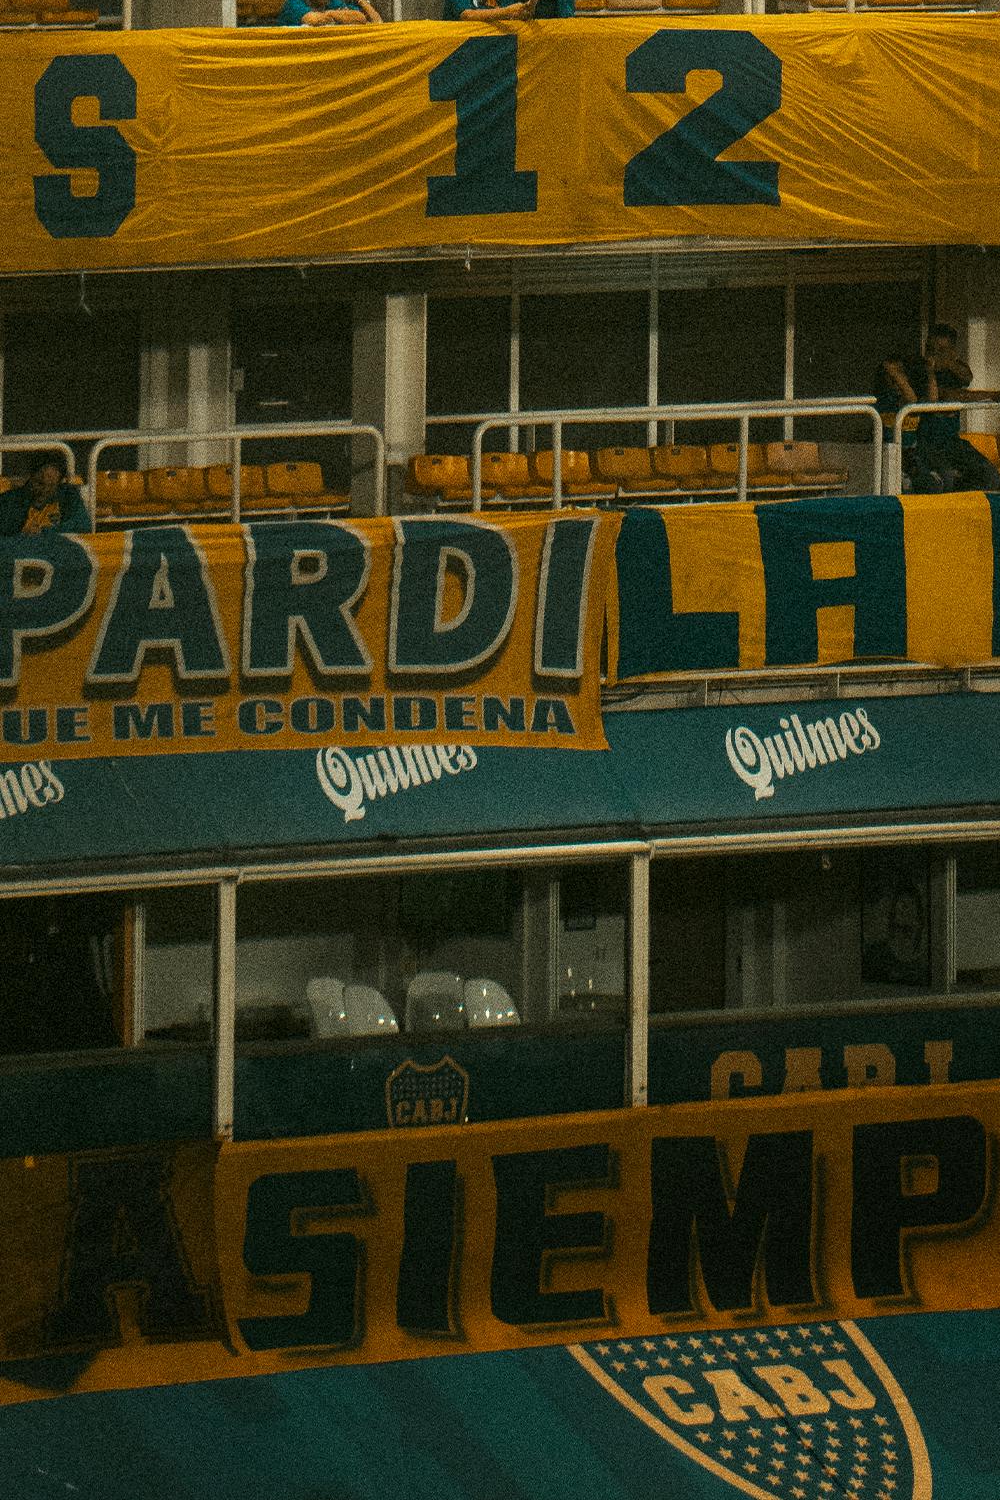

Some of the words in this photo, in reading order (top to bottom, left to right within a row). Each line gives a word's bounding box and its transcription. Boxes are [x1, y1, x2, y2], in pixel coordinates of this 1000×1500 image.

[33, 54, 138, 238] S
[425, 28, 783, 217] 12
[616, 494, 907, 678] LA
[112, 700, 217, 741] ME
[237, 694, 577, 735] CONDENA
[725, 706, 881, 800] Quilmes
[642, 1359, 876, 1425] CABJ
